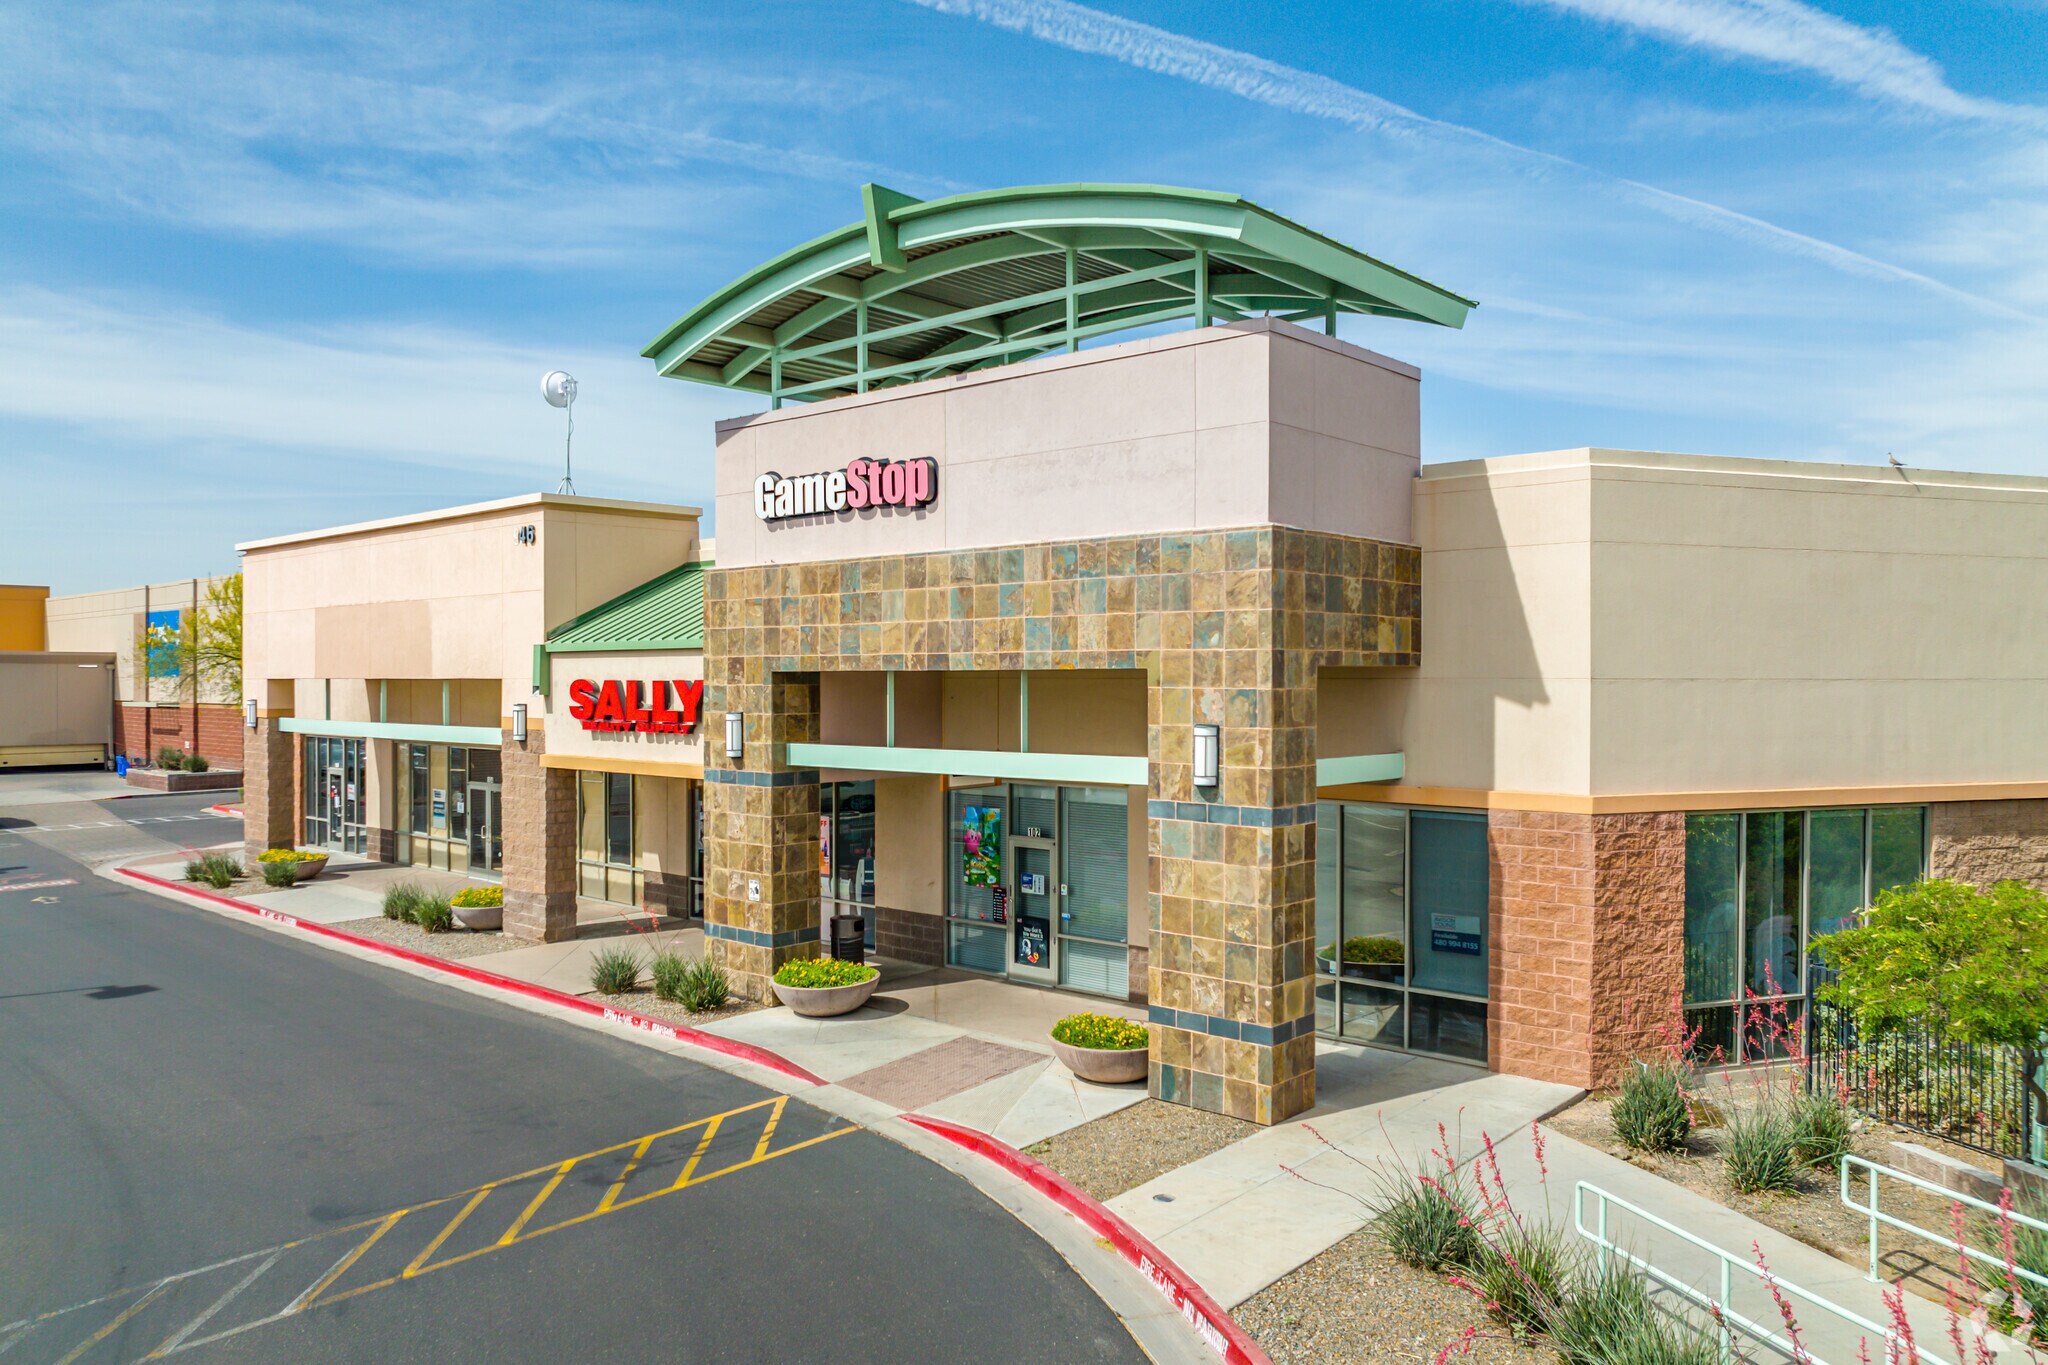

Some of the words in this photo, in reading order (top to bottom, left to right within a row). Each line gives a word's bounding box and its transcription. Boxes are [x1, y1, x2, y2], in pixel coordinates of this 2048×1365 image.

[754, 458, 933, 520] GameStop
[569, 678, 704, 722] SALLY
[636, 723, 692, 734] SUPPLY
[1028, 827, 1041, 838] 102
[1448, 940, 1461, 948] 994
[1462, 941, 1479, 950] 8155
[1183, 1297, 1195, 1323] NO
